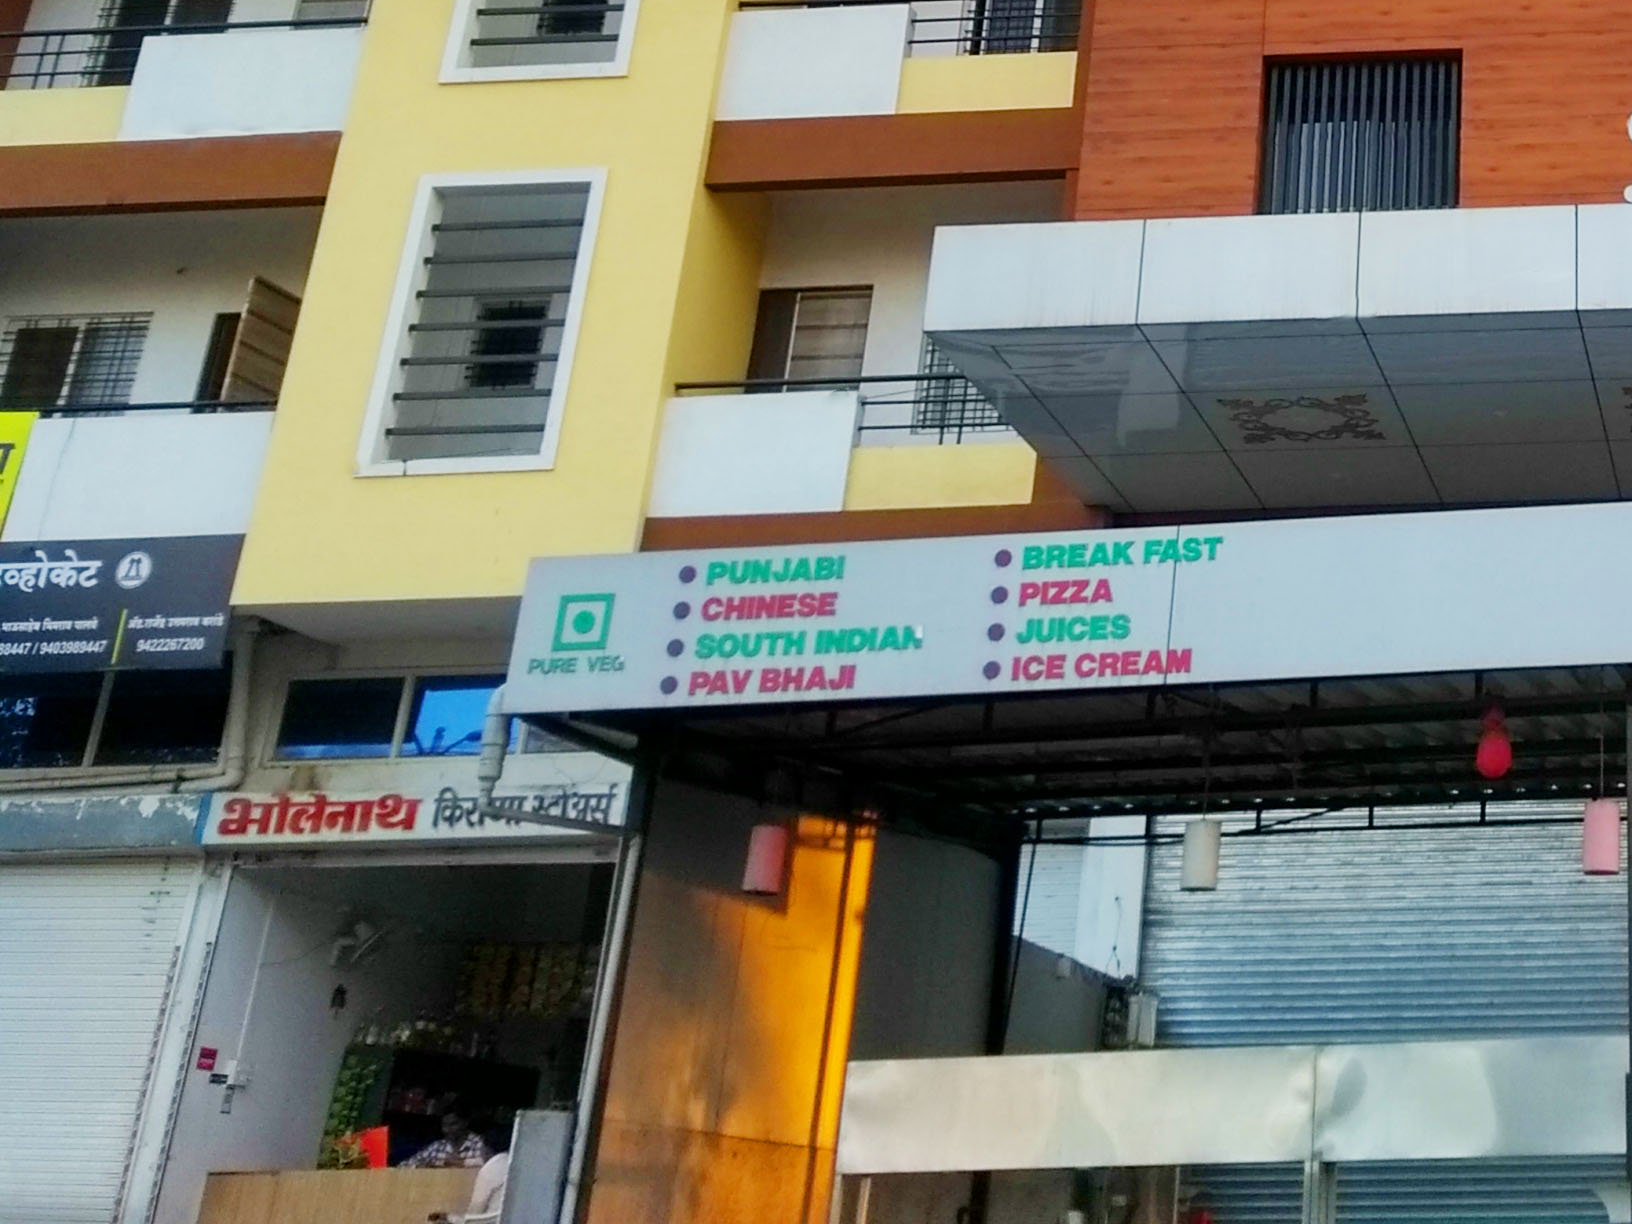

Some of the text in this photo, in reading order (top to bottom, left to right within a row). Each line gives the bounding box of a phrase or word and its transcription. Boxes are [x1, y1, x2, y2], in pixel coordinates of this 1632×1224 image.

[1022, 537, 1224, 570] BREAK FAST
[705, 556, 846, 585] PUNJABI
[701, 592, 838, 622] CHINESE
[1018, 579, 1113, 607] PIZZA
[694, 626, 923, 659] SOUTH INDIAN
[1015, 614, 1132, 644] JUICES
[527, 655, 625, 674] PURE VEG
[1011, 648, 1193, 681] ICE CREAM
[688, 665, 857, 696] PAV BHAJI
[217, 792, 424, 837] भोलेनाथ
